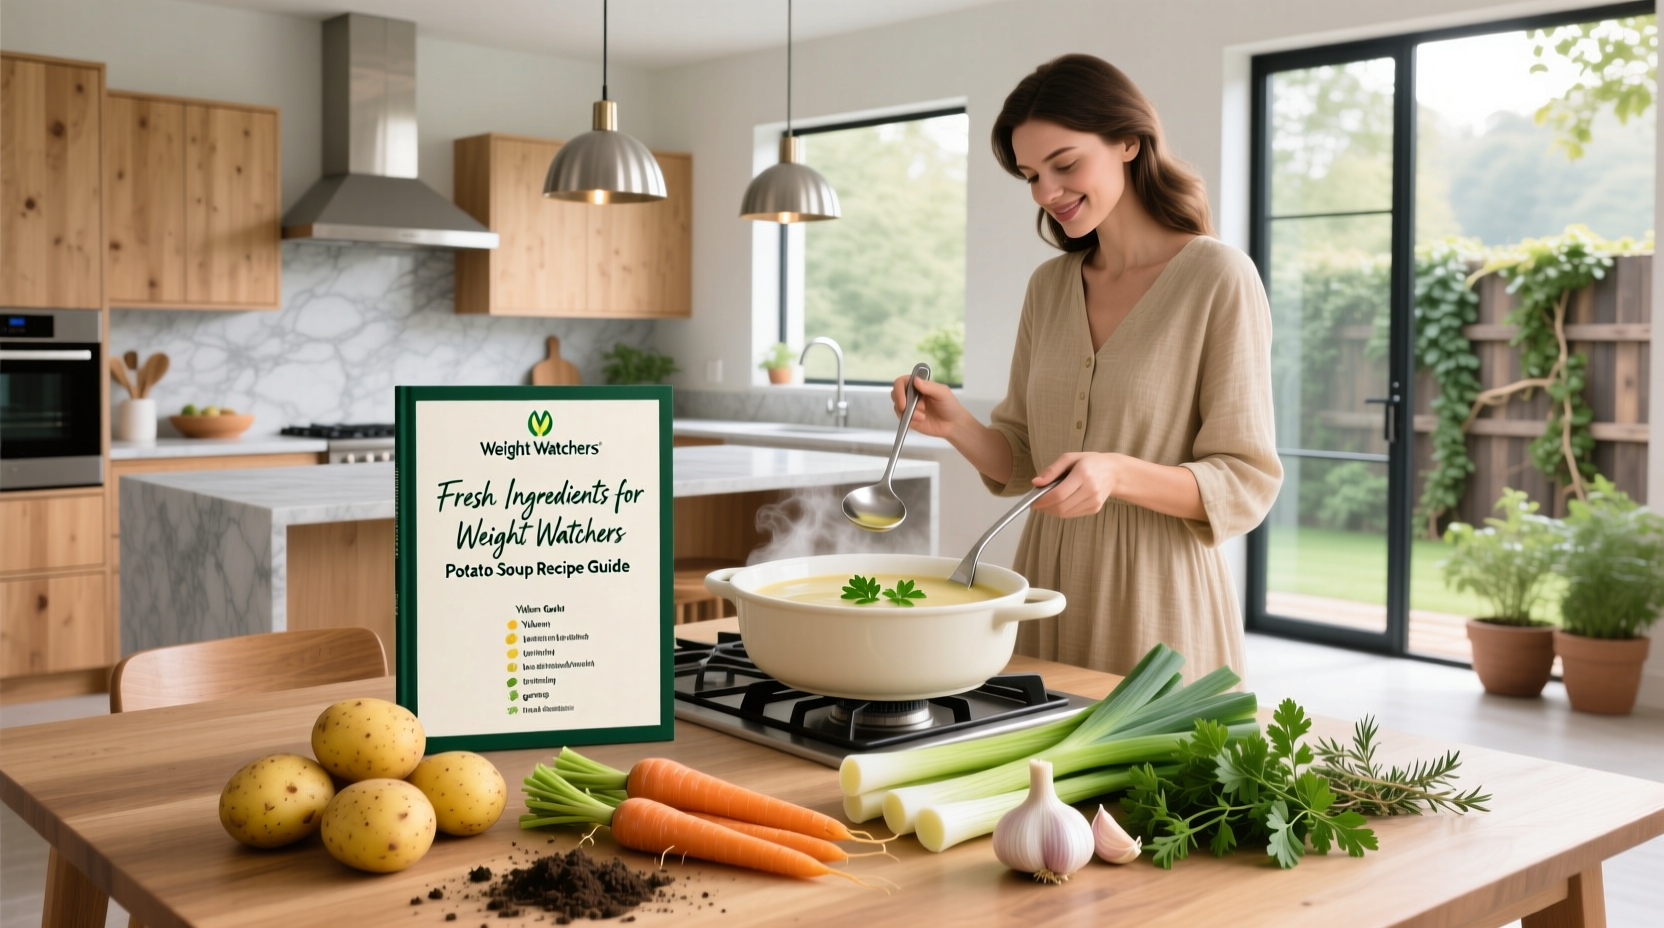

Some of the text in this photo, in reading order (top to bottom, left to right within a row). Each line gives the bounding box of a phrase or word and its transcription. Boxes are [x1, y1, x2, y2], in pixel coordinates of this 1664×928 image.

[480, 440, 530, 460] Weight
[437, 478, 644, 522] Fresh Ingredients for
[457, 516, 626, 559] Weight Watchers
[446, 559, 630, 579] Potato Soup Recipe Guide
